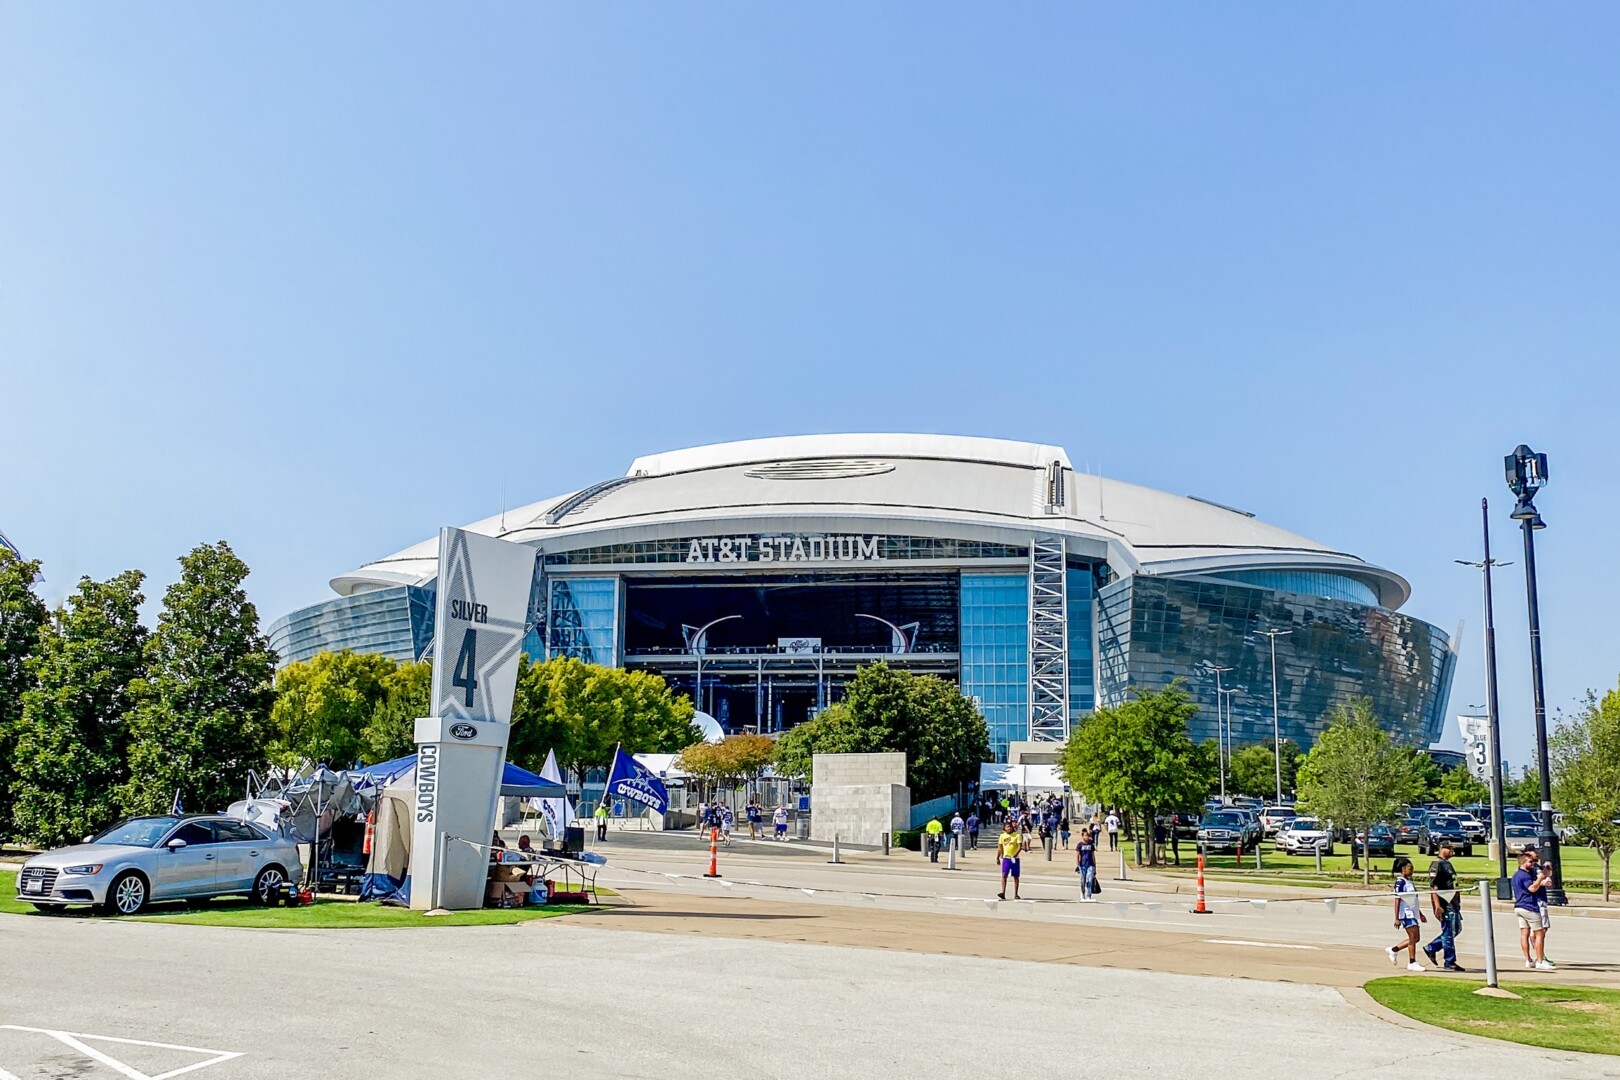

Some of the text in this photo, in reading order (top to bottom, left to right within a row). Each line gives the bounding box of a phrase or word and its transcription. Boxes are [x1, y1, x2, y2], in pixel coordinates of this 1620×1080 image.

[686, 536, 881, 563] AT&T STADIUM
[451, 599, 488, 624] SILVER
[453, 628, 477, 708] 4
[1476, 742, 1487, 765] 3
[417, 745, 437, 823] COWBOYS
[952, 822, 962, 830] 22
